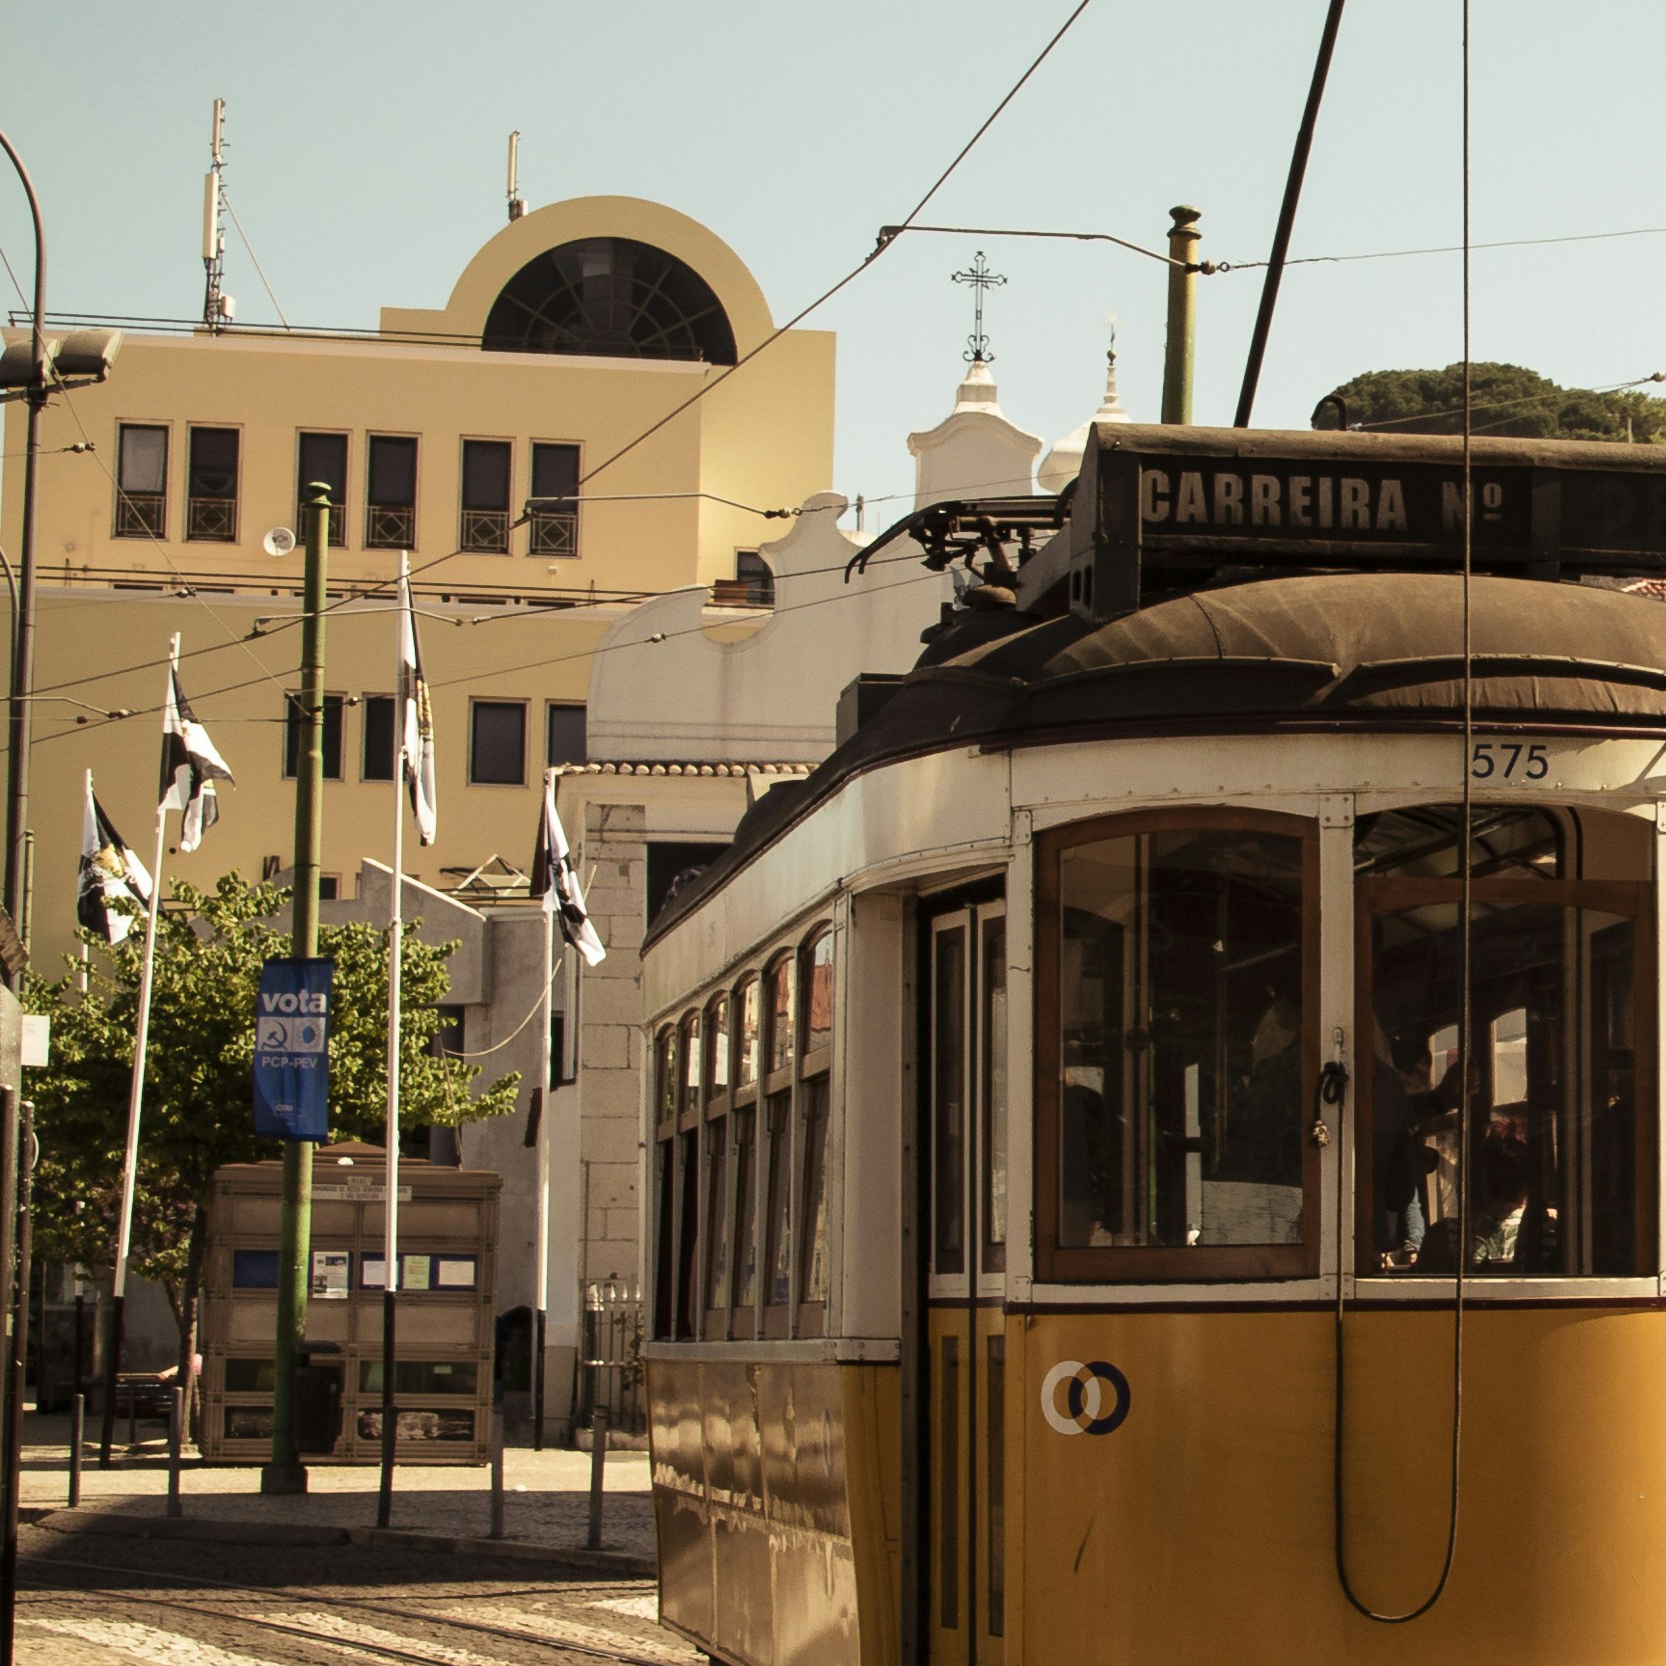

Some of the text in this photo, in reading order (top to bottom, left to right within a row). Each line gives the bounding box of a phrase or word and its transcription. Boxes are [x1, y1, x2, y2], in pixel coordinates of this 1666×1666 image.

[1141, 469, 1408, 531] CARREIRA
[1471, 743, 1549, 780] 575
[262, 988, 327, 1014] vota
[262, 1056, 318, 1068] PCP-PEV
